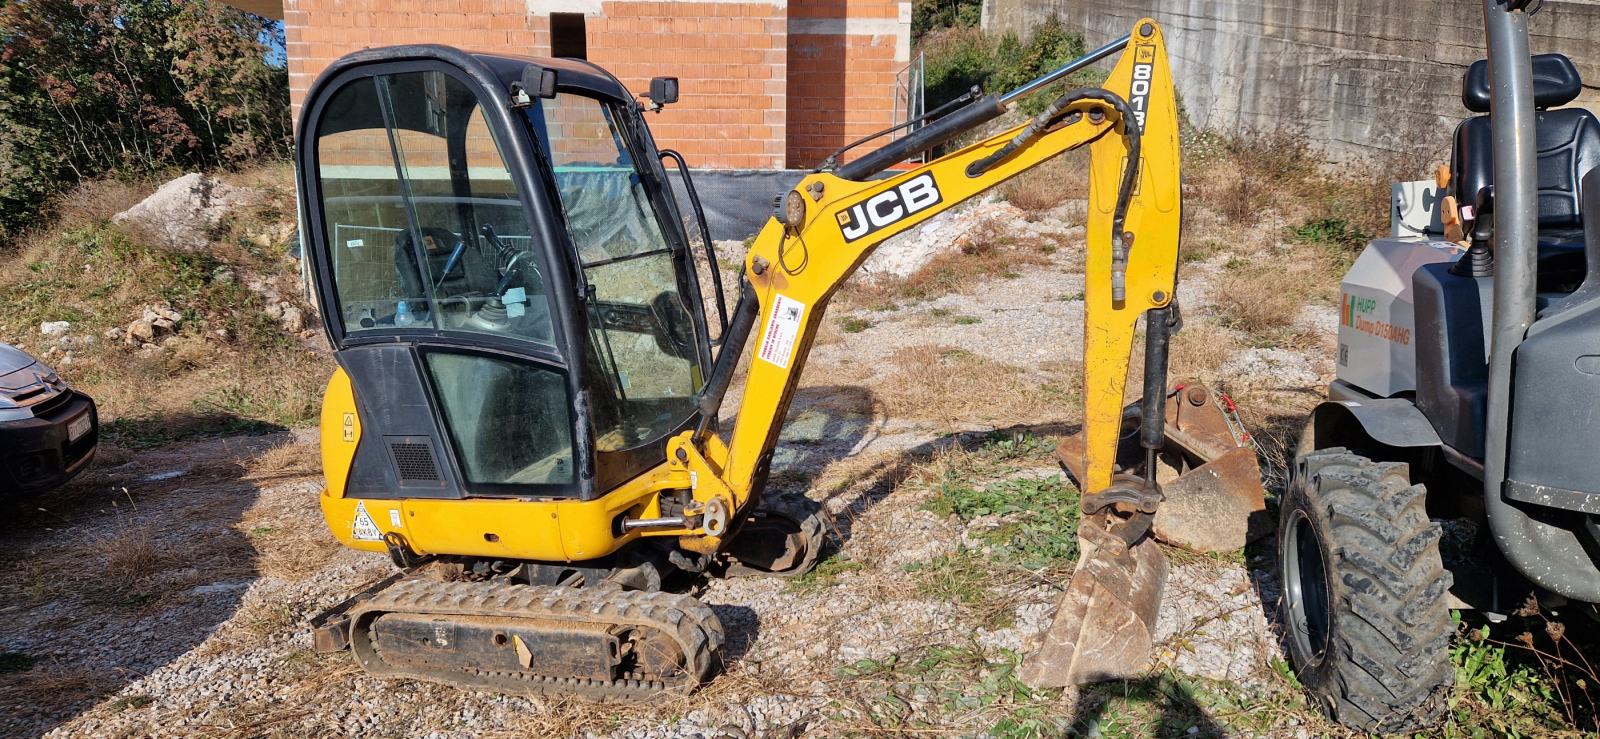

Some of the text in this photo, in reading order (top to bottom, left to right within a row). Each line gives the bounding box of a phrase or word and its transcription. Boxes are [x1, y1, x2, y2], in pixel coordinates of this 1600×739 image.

[843, 175, 939, 240] JCB
[1357, 298, 1376, 313] HUPP
[1355, 315, 1374, 336] Dump
